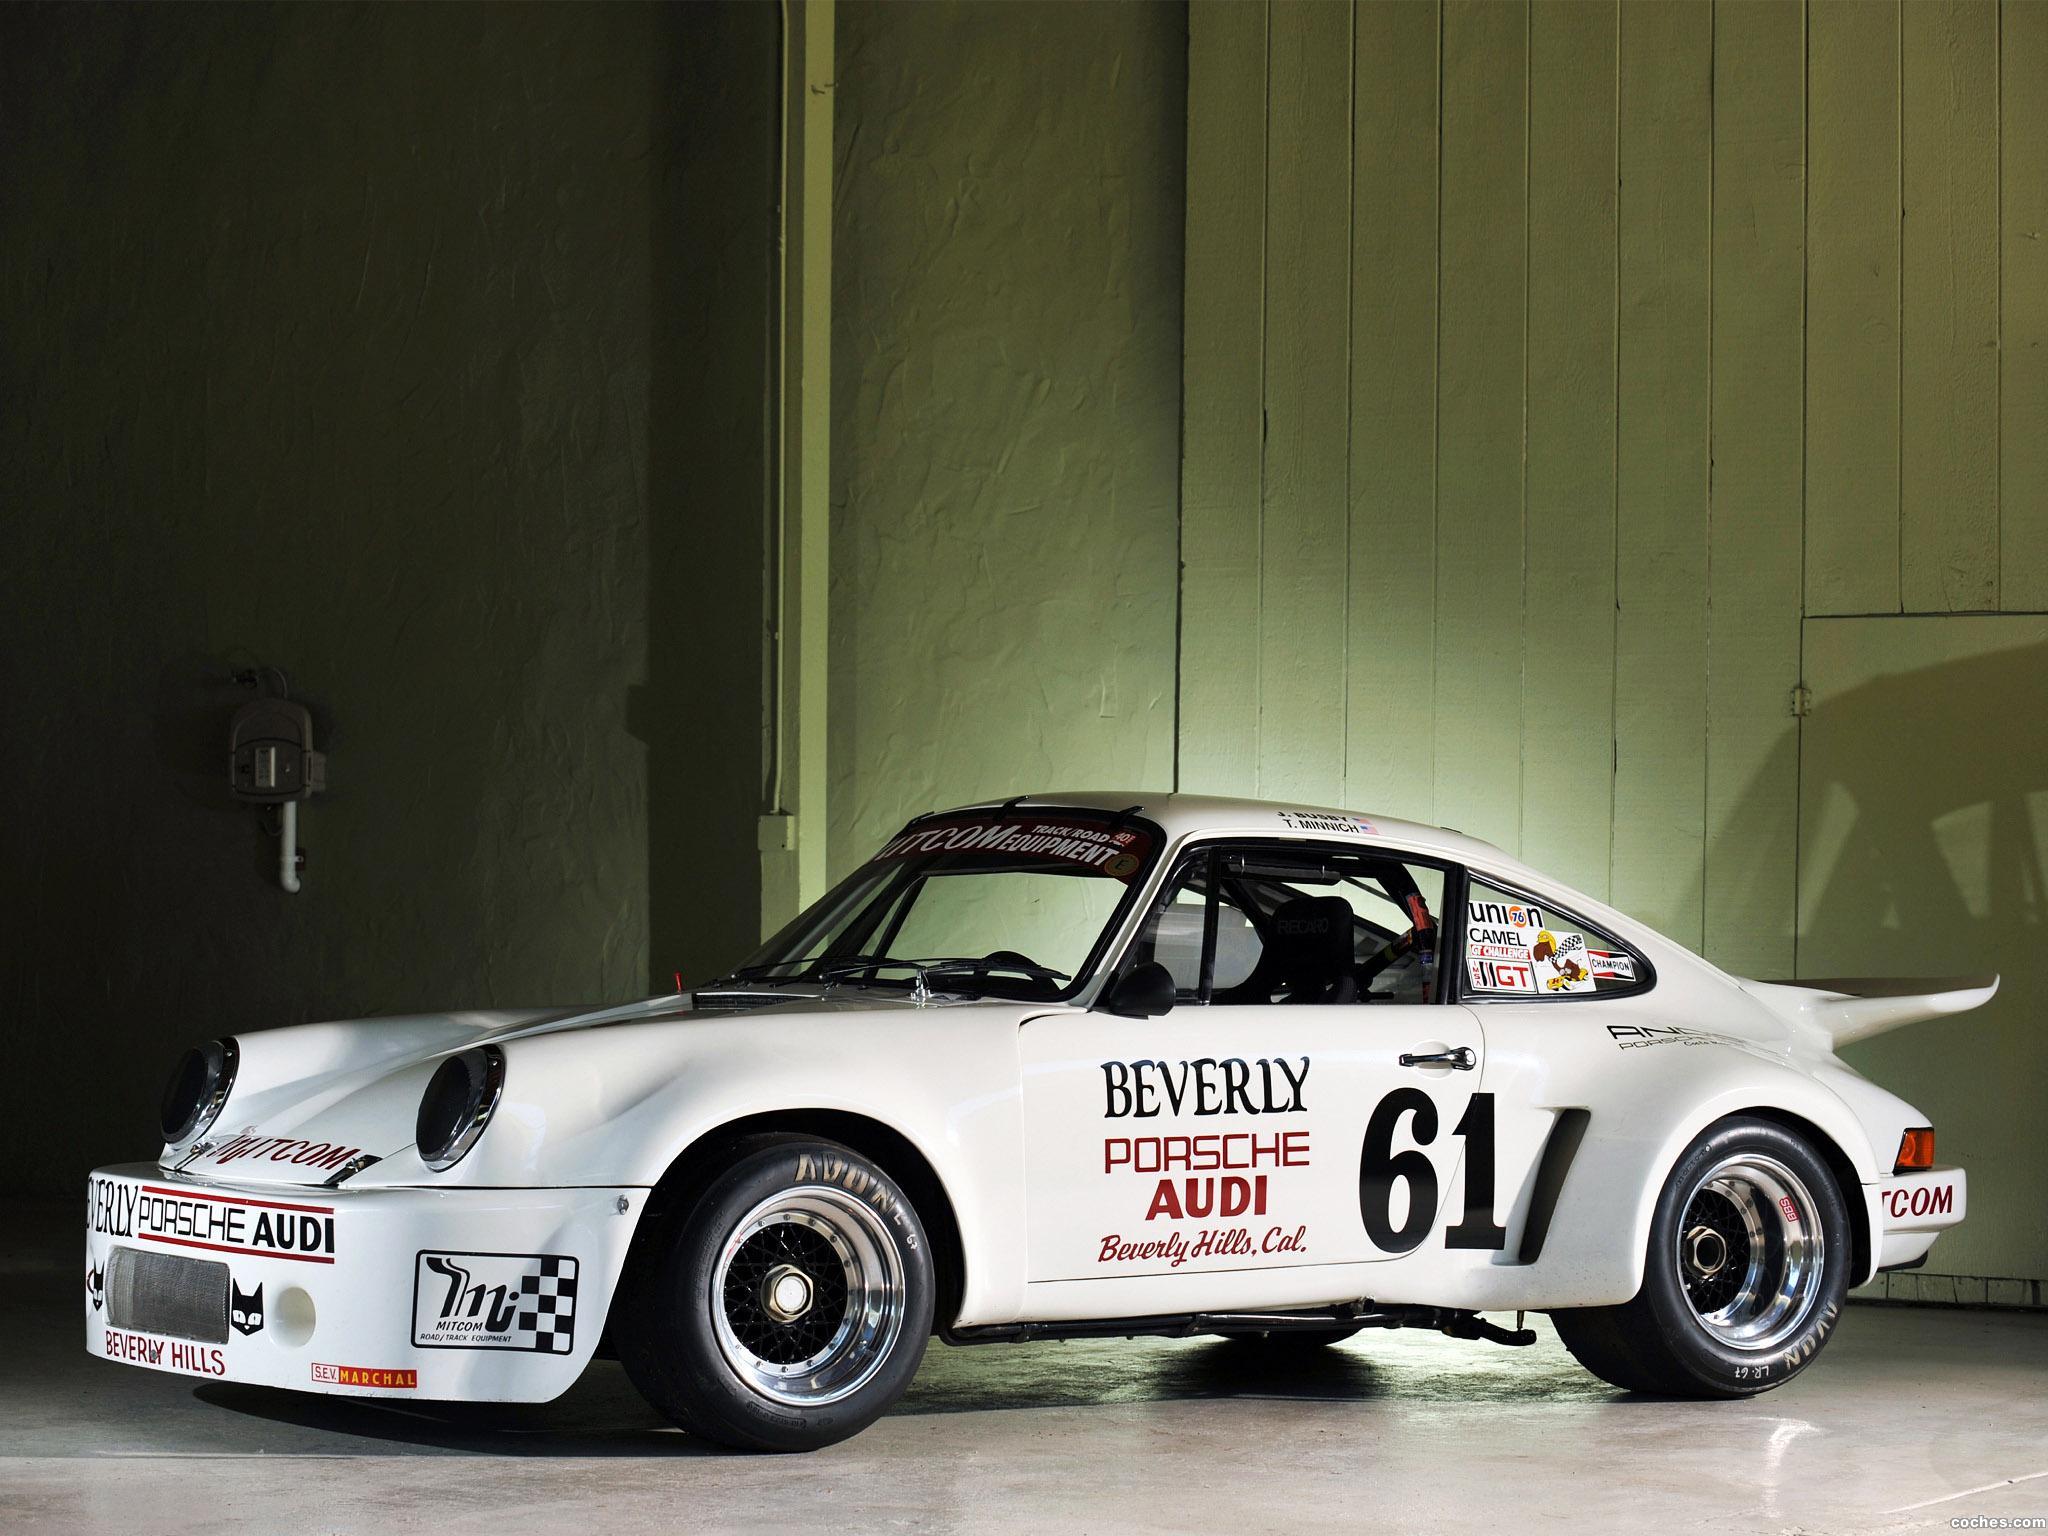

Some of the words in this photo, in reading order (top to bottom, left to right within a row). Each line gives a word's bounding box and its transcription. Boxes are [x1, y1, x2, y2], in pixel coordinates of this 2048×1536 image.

[1282, 818, 1298, 829] T.
[1299, 819, 1360, 834] MINNICH
[1293, 812, 1348, 822] BUSBY
[1001, 834, 1119, 866] EQUIPMENT
[1277, 918, 1329, 936] RECARO
[1511, 912, 1525, 923] 76
[1469, 928, 1527, 947] CAMEL
[1471, 945, 1482, 956] GT
[1483, 946, 1530, 959] CHALLENGE
[1496, 965, 1529, 988] GT
[1591, 958, 1630, 971] CHAMPION
[1100, 1056, 1311, 1119] BEVERLY
[1104, 1131, 1310, 1174] PORSCHE
[1359, 1086, 1508, 1254] 61
[794, 1153, 896, 1214] AVON
[1145, 1175, 1268, 1221] AUDI
[1779, 1197, 1798, 1222] BBS
[138, 1196, 246, 1244] PORSCHE
[252, 1211, 335, 1254] AUDI
[1098, 1231, 1190, 1268] Beverly
[1190, 1228, 1257, 1258] Hills,
[1261, 1225, 1307, 1254] Cal.
[436, 1320, 483, 1332] MITCOM
[1782, 1301, 1838, 1371] AVON
[471, 1334, 512, 1343] EQUIPMENT
[105, 1330, 165, 1365] BEVERLY
[171, 1342, 226, 1376] HILLS
[314, 1365, 337, 1380] S.E.V.
[339, 1369, 416, 1386] MARCHAL
